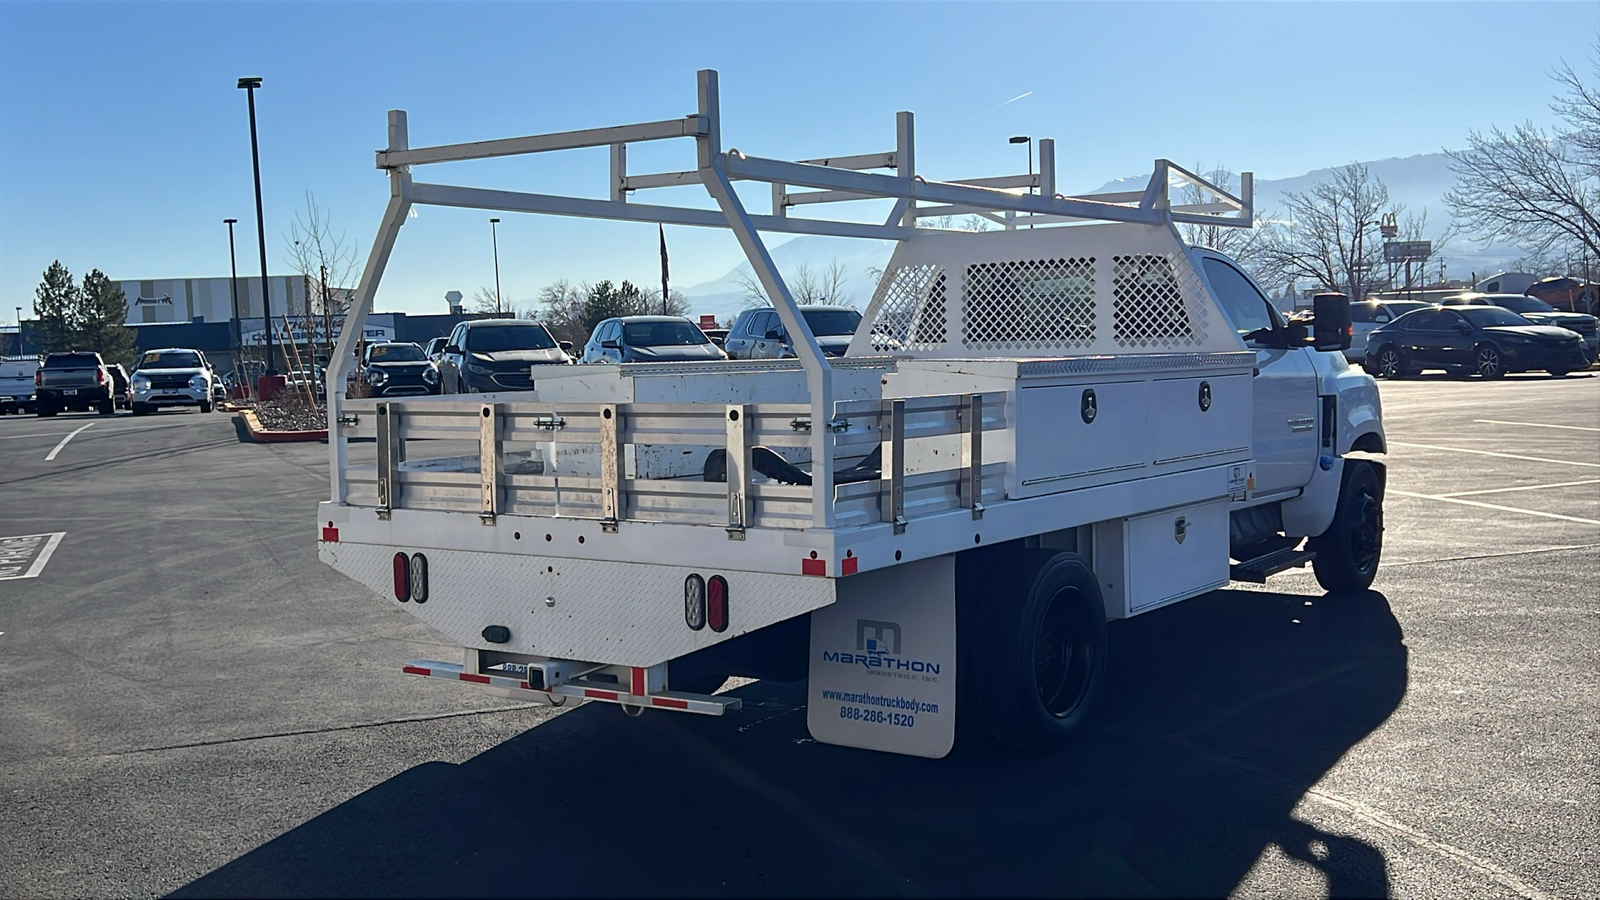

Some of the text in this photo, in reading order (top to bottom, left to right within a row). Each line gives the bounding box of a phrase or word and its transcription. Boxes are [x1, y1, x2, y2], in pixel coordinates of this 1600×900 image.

[252, 331, 325, 341] COLLSION
[823, 650, 940, 674] MARATHON
[822, 689, 939, 713] www.marathontruckbody.com
[840, 706, 914, 727] 888-286-1520
